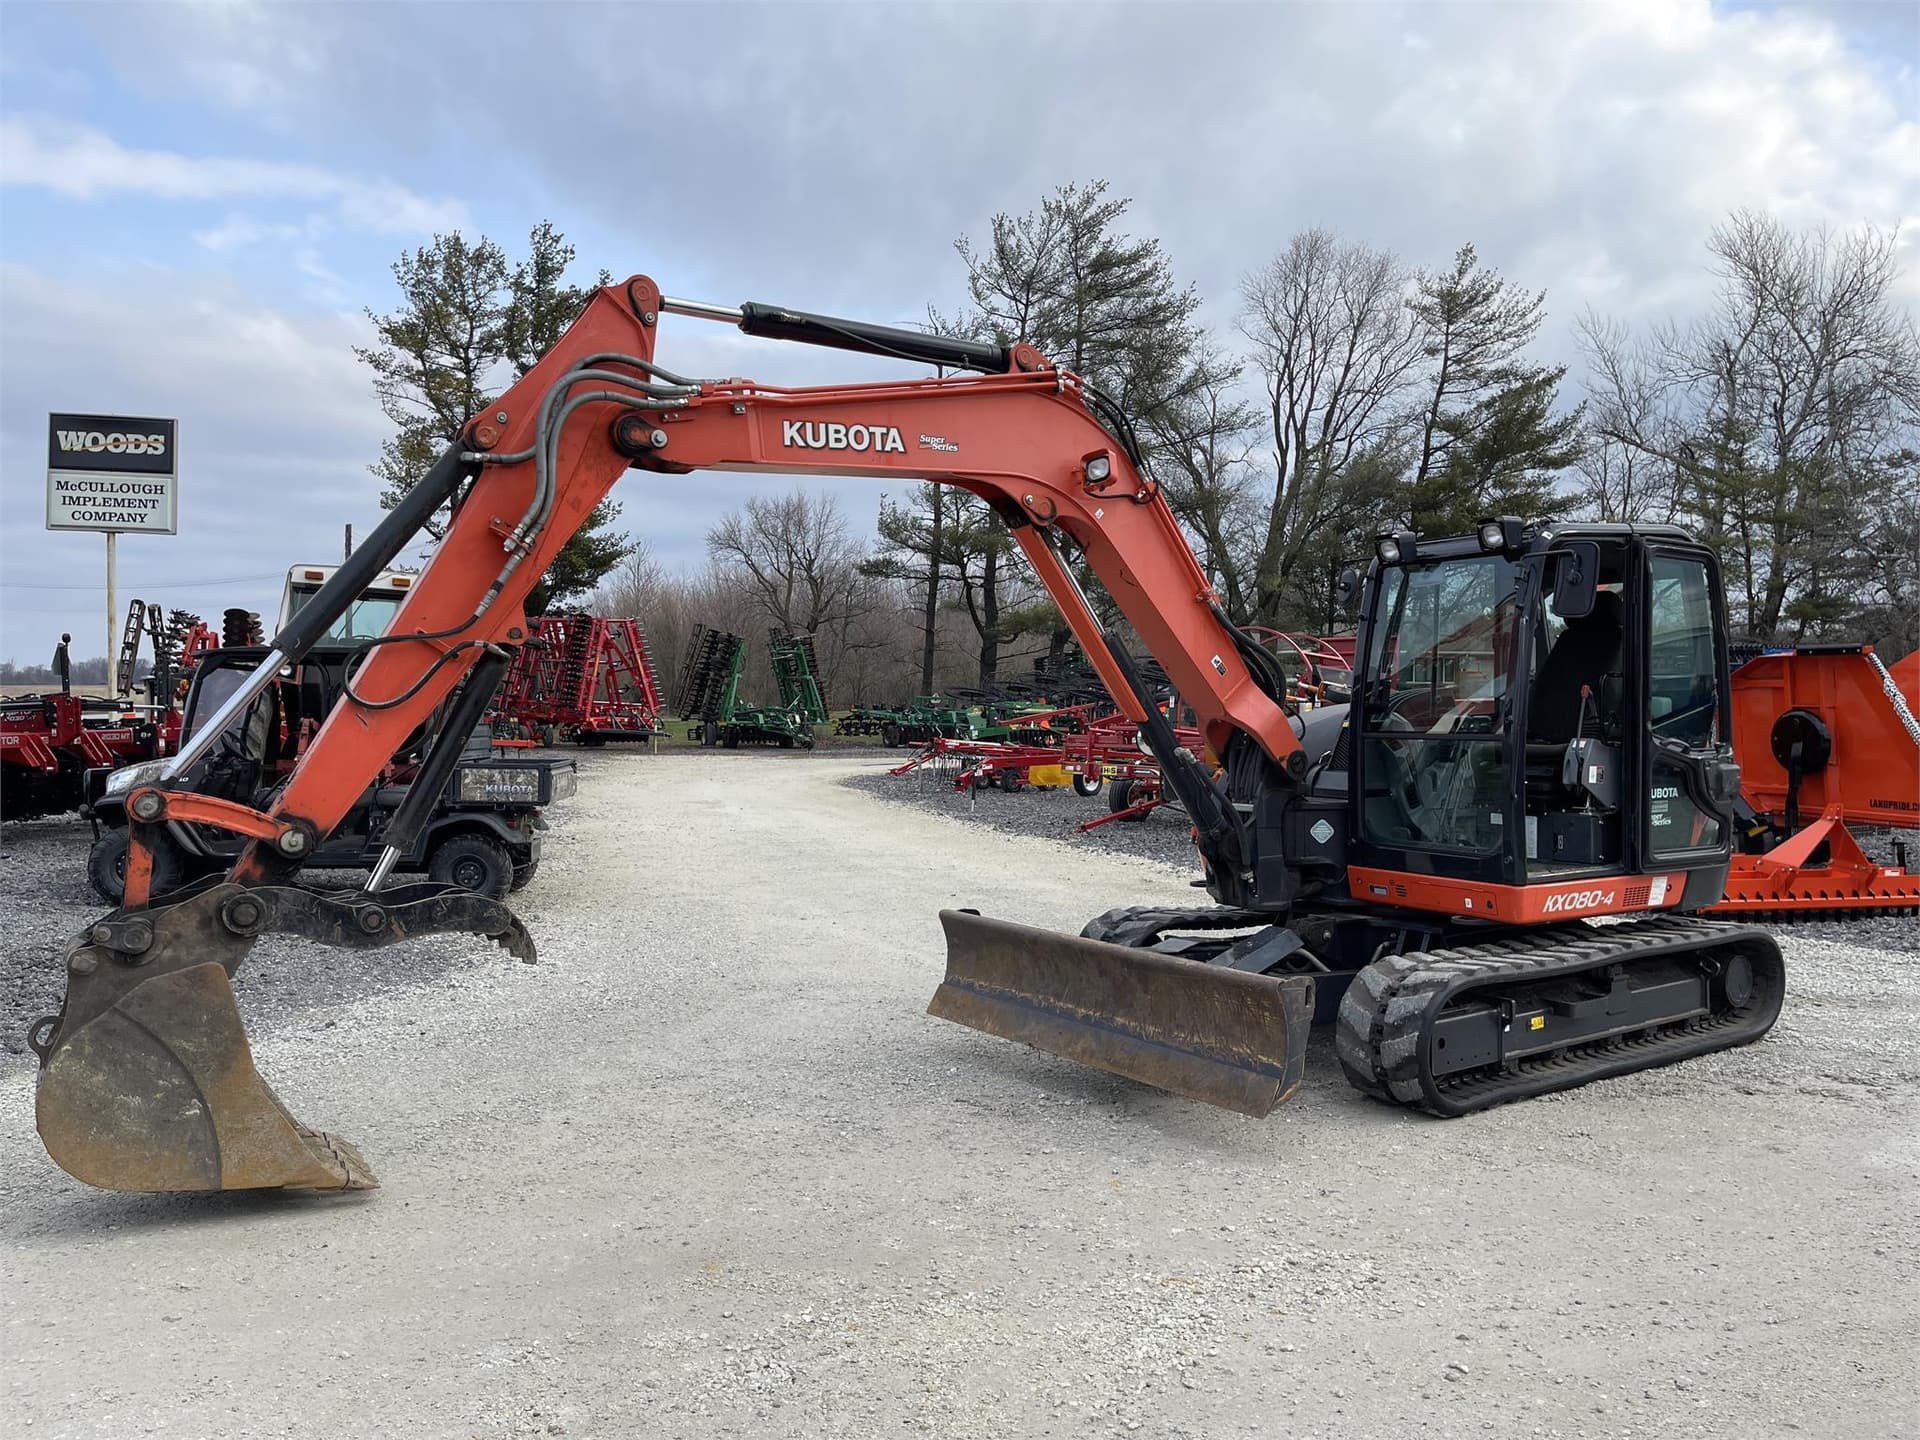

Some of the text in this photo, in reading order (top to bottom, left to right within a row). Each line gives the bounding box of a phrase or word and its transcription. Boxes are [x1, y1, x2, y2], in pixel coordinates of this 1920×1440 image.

[57, 431, 165, 455] WOODS
[782, 420, 906, 453] KUBOTA
[919, 434, 945, 445] Super
[932, 442, 959, 452] Series
[56, 480, 165, 495] McCULLOUGH
[61, 495, 159, 509] IMPLEMENT
[71, 511, 148, 524] COMPANY
[0, 736, 20, 745] TOR
[485, 784, 533, 794] KUBOTA
[1651, 787, 1679, 799] UBOTA
[1542, 890, 1615, 913] KX080-4
